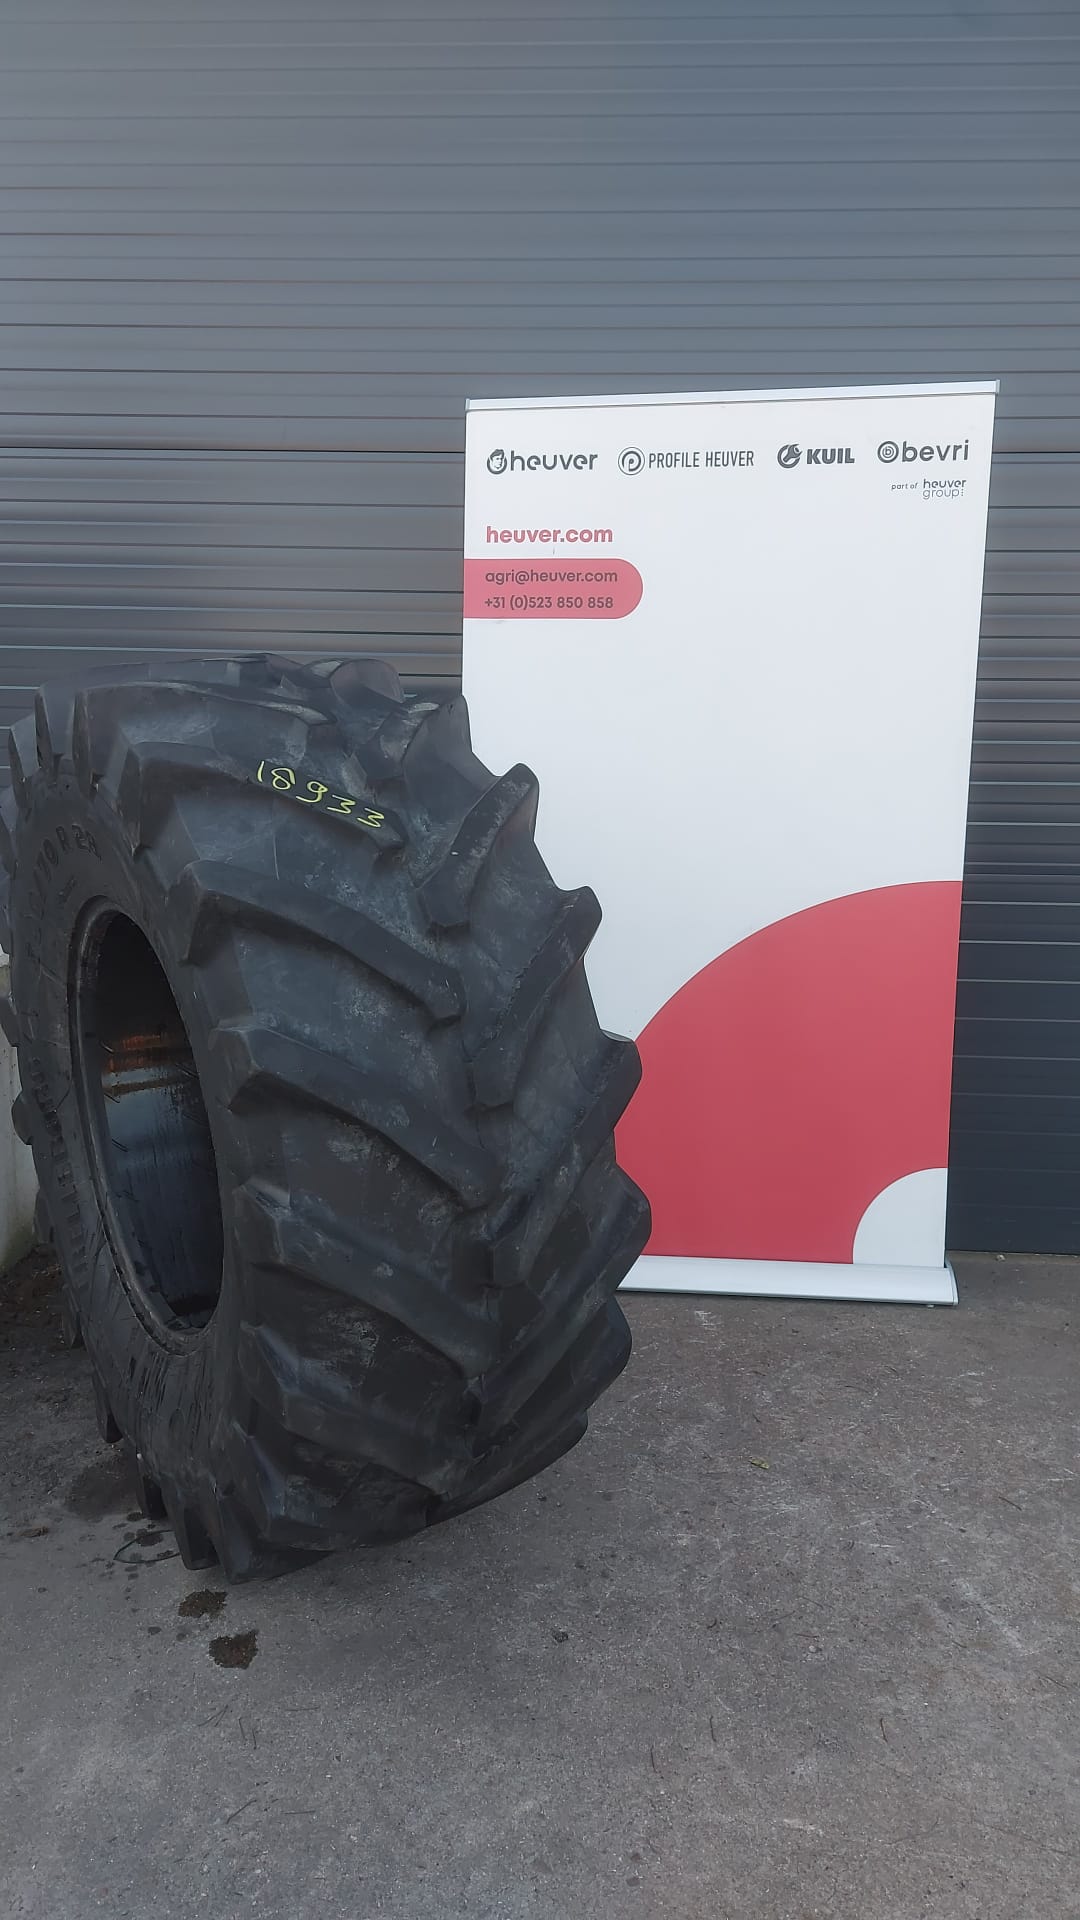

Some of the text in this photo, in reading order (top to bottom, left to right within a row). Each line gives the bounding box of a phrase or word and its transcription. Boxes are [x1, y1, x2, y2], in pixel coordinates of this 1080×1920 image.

[806, 448, 855, 464] KUIL
[901, 439, 969, 462] bevri
[510, 450, 598, 471] heuver
[649, 450, 754, 469] PROFILE HEUVER
[891, 482, 918, 491] part of
[923, 478, 967, 488] heuver
[922, 488, 960, 500] group
[486, 526, 613, 543] heuver.com
[485, 569, 618, 585] agri@heuver.com
[484, 596, 614, 610] +31 (0)523 850 858
[257, 760, 385, 828] 18933
